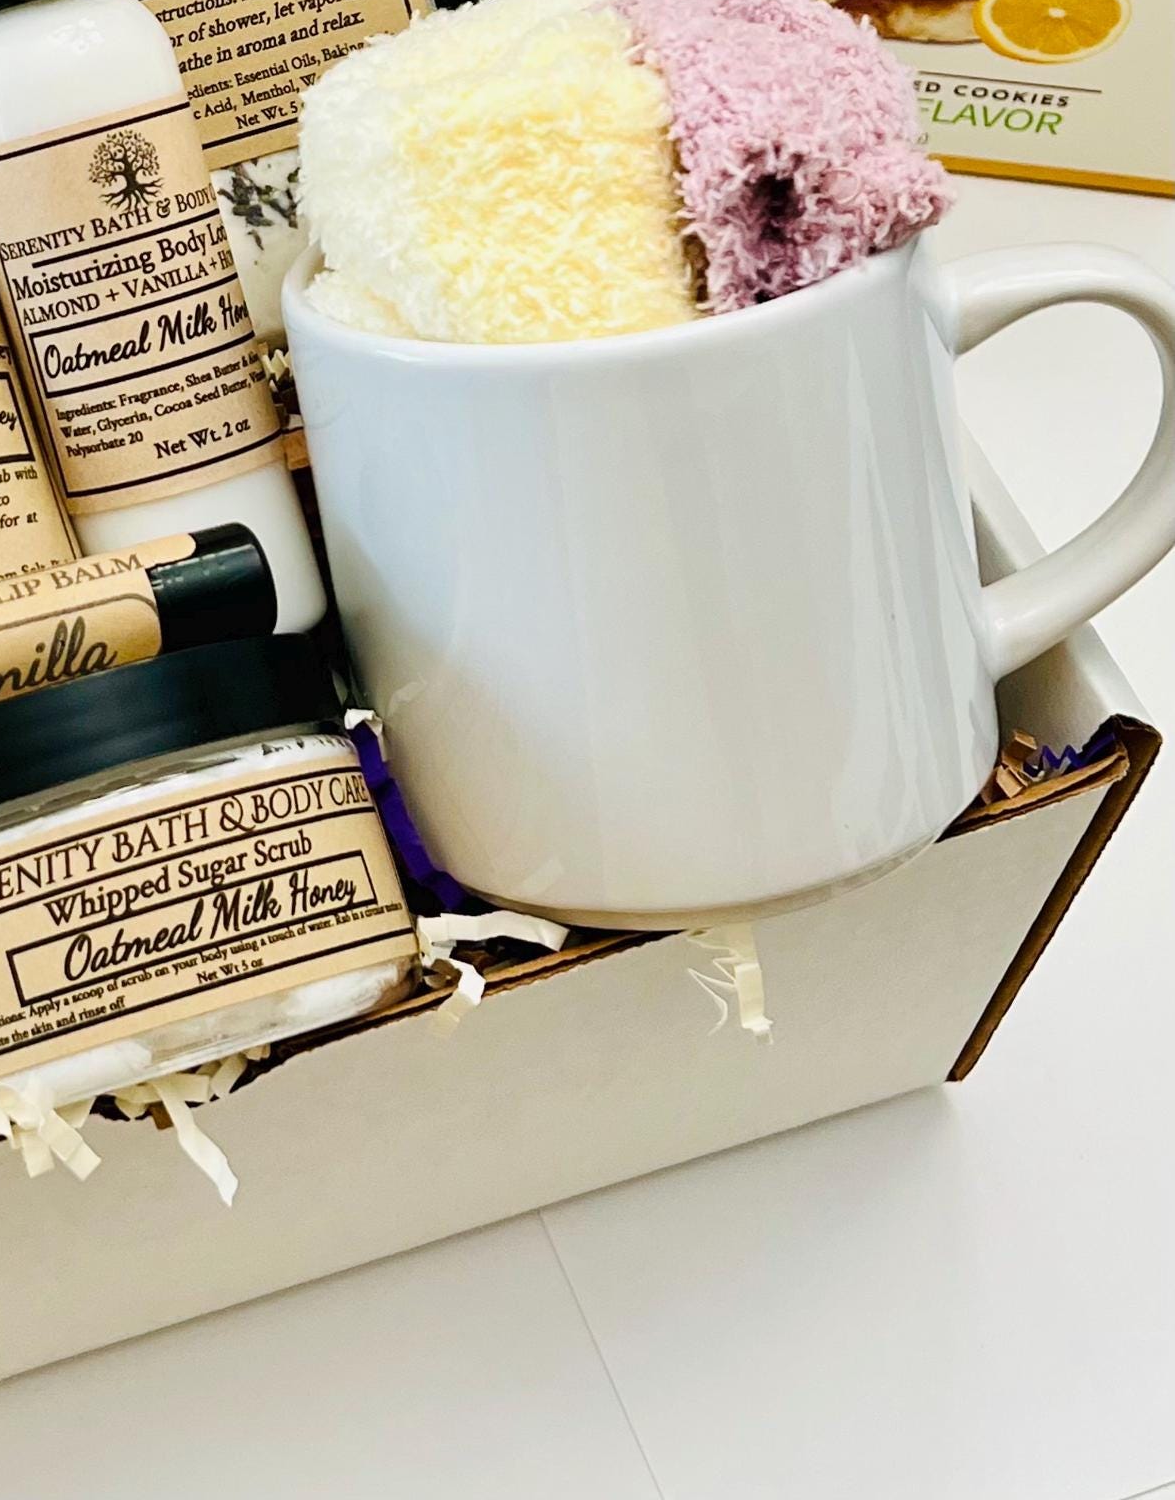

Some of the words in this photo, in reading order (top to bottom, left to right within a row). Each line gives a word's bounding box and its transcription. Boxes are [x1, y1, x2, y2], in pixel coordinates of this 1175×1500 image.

[208, 8, 271, 38] shower,
[274, 2, 295, 20] let
[236, 36, 287, 58] aroma
[291, 21, 319, 41] and
[234, 60, 290, 86] Essential
[954, 85, 1070, 108] COOKIES
[0, 225, 86, 262] SERENITY
[90, 206, 153, 239] BATH
[12, 252, 156, 300] Moisturizing
[157, 229, 207, 263] Body
[23, 292, 101, 326] ALMOND
[123, 261, 209, 298] VANILLA
[44, 321, 152, 379] Oatmeal
[158, 303, 217, 352] Milk
[186, 370, 212, 388] Shea
[155, 399, 192, 417] Cocoa
[195, 388, 220, 404] Seed
[154, 438, 186, 459] Net
[0, 513, 20, 531] for
[52, 553, 144, 590] BALM
[112, 807, 209, 863] BATH
[250, 780, 324, 823] BODY
[329, 774, 368, 805] CARE
[43, 865, 171, 927] Whipped
[178, 852, 247, 885] Sugar
[254, 829, 312, 867] Scrub
[65, 898, 204, 981] Oatmeal
[210, 879, 281, 940] Milk
[289, 869, 356, 916] Honey
[29, 995, 61, 1019] Apply
[200, 944, 228, 966] body
